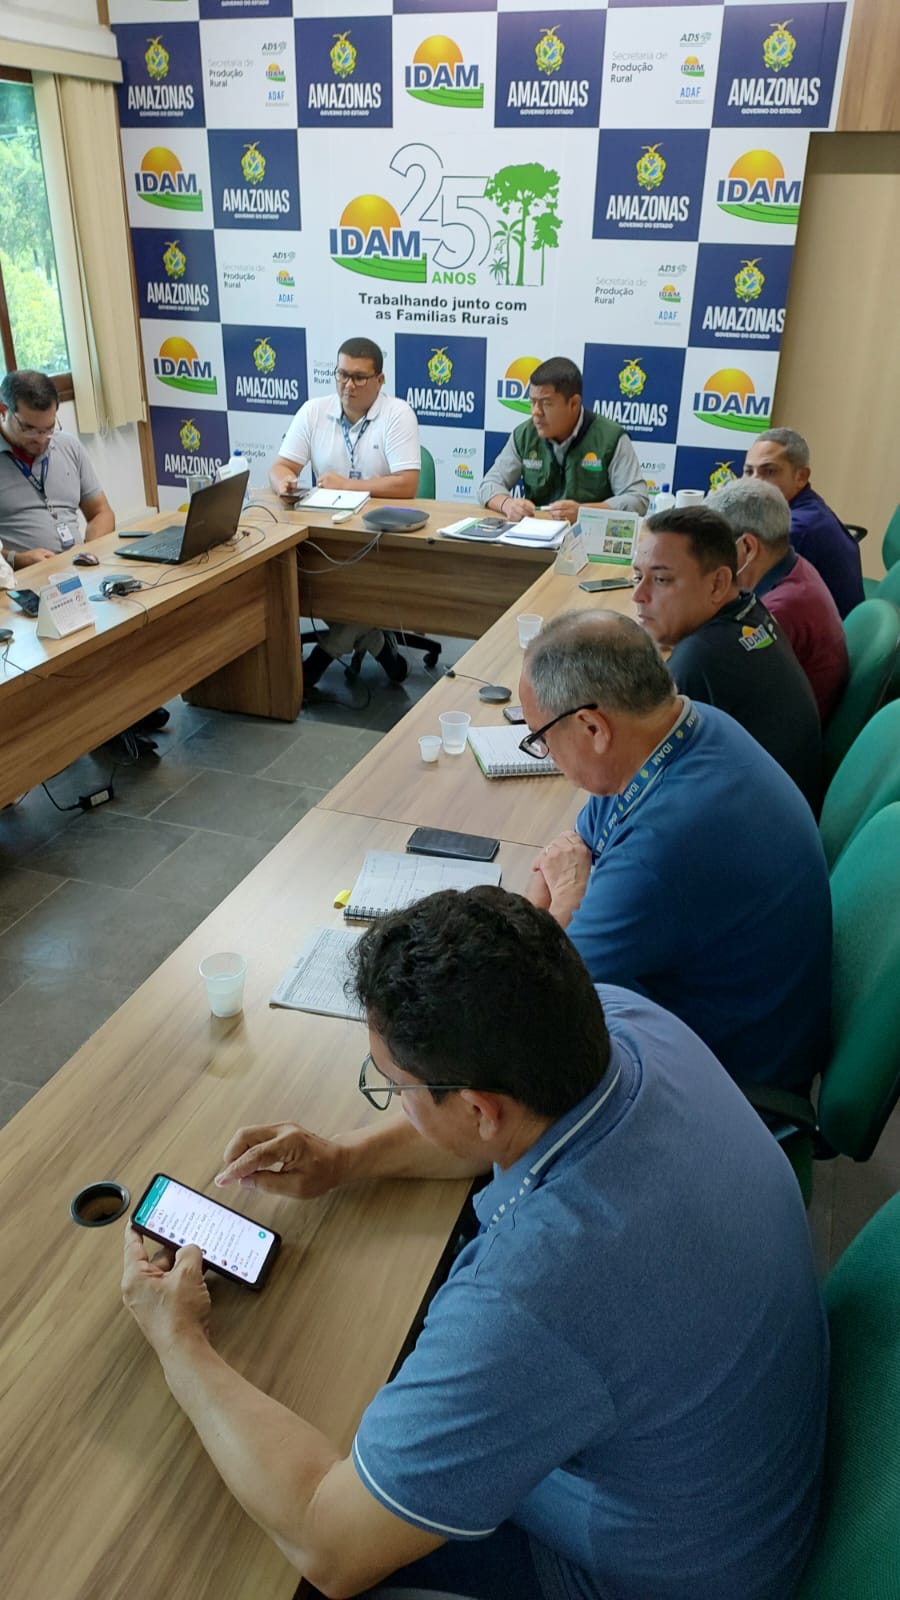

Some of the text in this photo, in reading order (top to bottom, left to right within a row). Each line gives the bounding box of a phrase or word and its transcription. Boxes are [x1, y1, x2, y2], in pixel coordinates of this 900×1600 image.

[680, 33, 699, 42] ADS
[209, 70, 244, 79] Produção
[405, 64, 479, 88] IDAM
[610, 74, 632, 83] Rural
[612, 62, 653, 73] Produção
[210, 80, 228, 88] Rural
[268, 90, 285, 100] ADAF
[308, 82, 382, 109] AMAZONAS
[507, 80, 589, 108] AMAZONAS
[680, 87, 702, 97] ADAF
[728, 78, 820, 106] AMAZONAS
[128, 84, 194, 110] AMAZONAS
[134, 172, 198, 193] IDAM
[717, 180, 801, 204] IDAM
[223, 189, 290, 213] AMAZONAS
[389, 142, 492, 270] 25
[606, 195, 690, 222] AMAZONAS
[330, 228, 420, 258] IDAM
[432, 272, 476, 286] ANOS
[147, 282, 209, 306] AMAZONAS
[358, 292, 527, 311] Trabalhando junto com
[594, 297, 615, 305] Rural
[595, 287, 634, 297] Produção
[376, 309, 509, 325] as Famílias Rurais
[659, 311, 678, 320] ADAF
[702, 306, 786, 333] AMAZONAS
[153, 358, 211, 378] IDAM
[236, 376, 298, 400] AMAZONAS
[407, 387, 474, 413] AMAZONAS
[593, 400, 668, 426] AMAZONAS
[693, 392, 770, 415] IDAM
[740, 625, 770, 650] IDAM
[651, 742, 673, 766] IDAM
